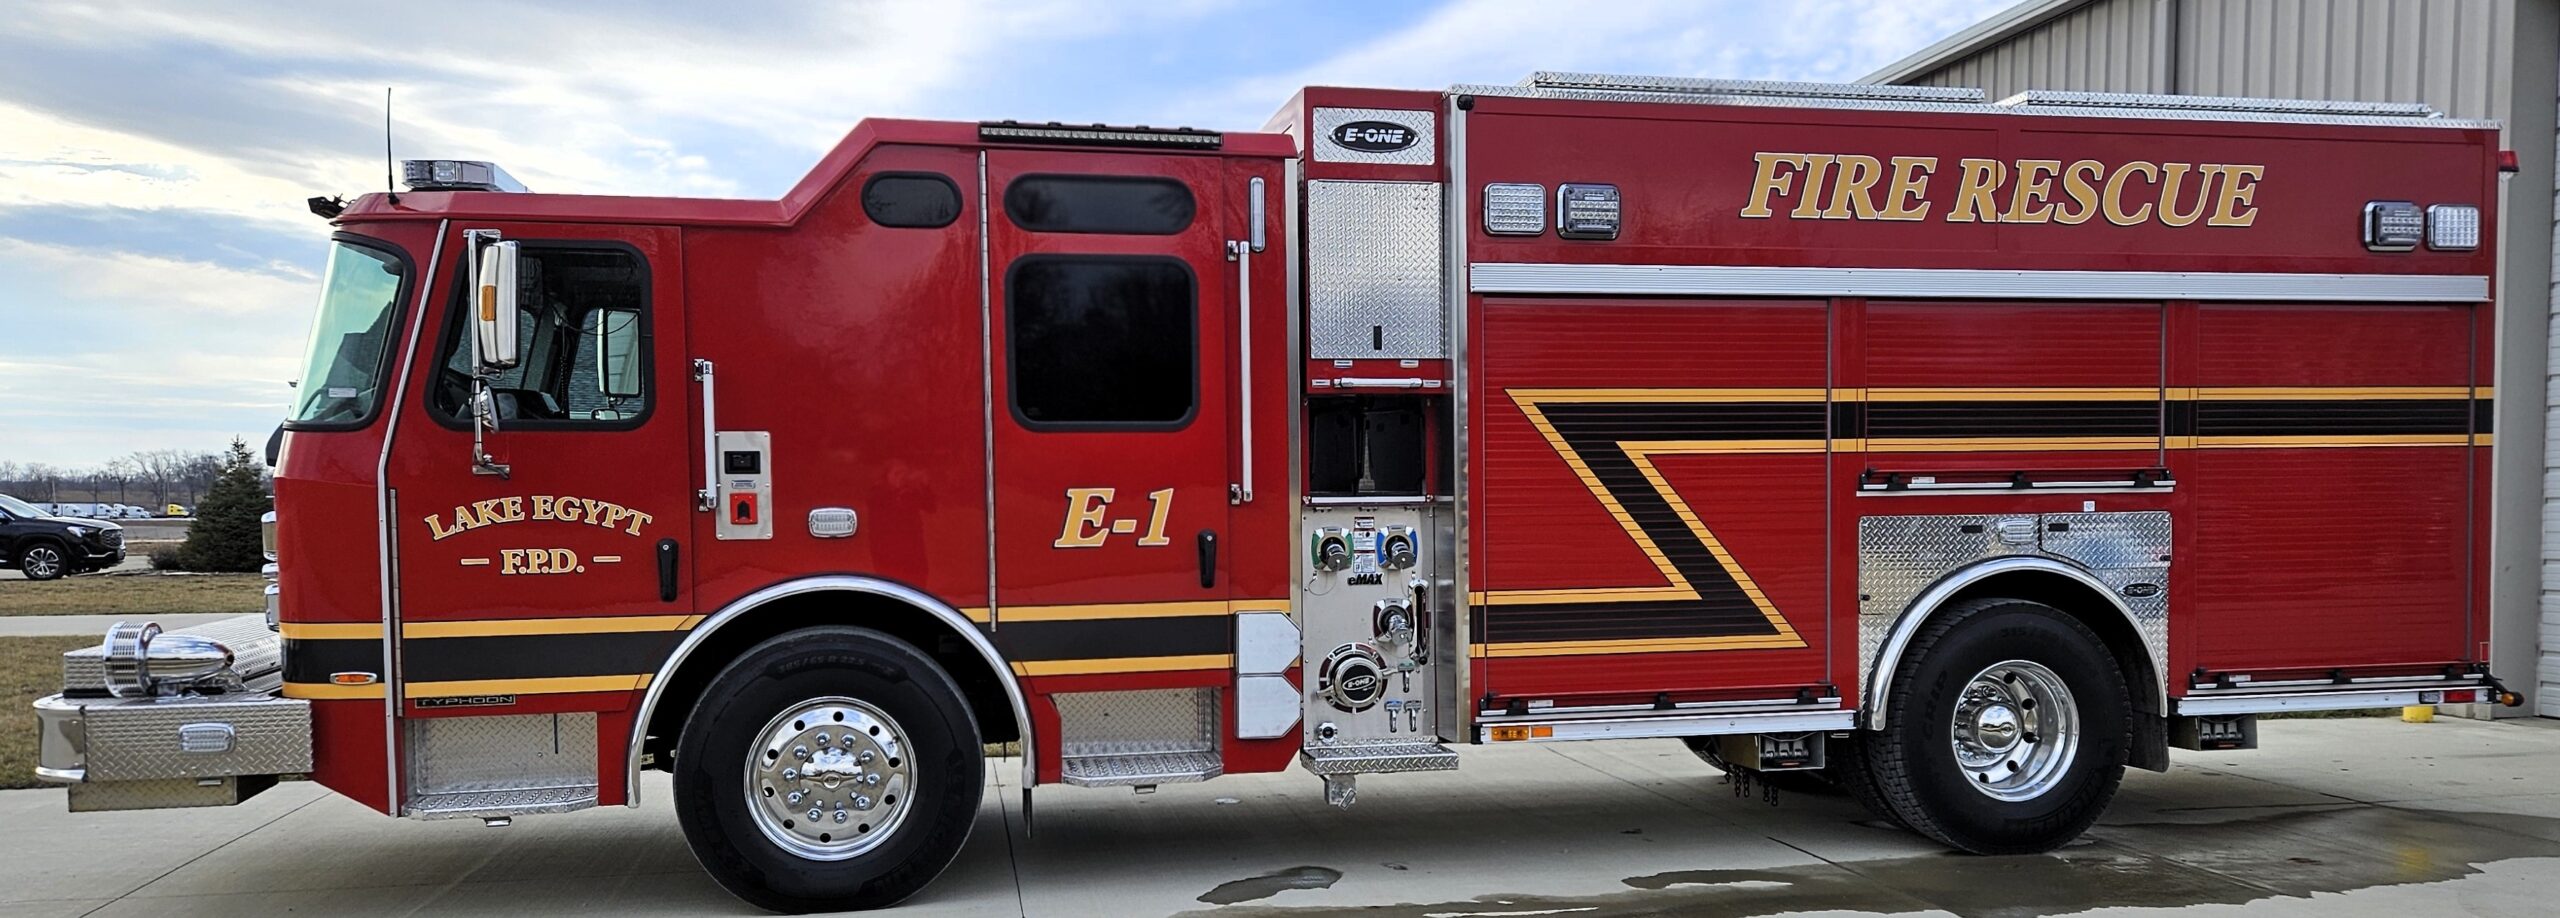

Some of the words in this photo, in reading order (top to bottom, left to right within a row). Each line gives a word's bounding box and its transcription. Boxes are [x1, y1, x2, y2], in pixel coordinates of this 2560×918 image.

[1344, 127, 1405, 144] E-ONE
[1740, 151, 1937, 221] FIRE
[1947, 158, 2264, 228] RESCUE
[424, 496, 526, 541] LAKE
[531, 495, 653, 537] EGYPT
[1053, 487, 1174, 549] E-1
[500, 548, 585, 575] F.P.D.
[1347, 573, 1384, 586] eMAX
[1347, 677, 1370, 688] E-ONE
[421, 695, 513, 706] TYPHOON
